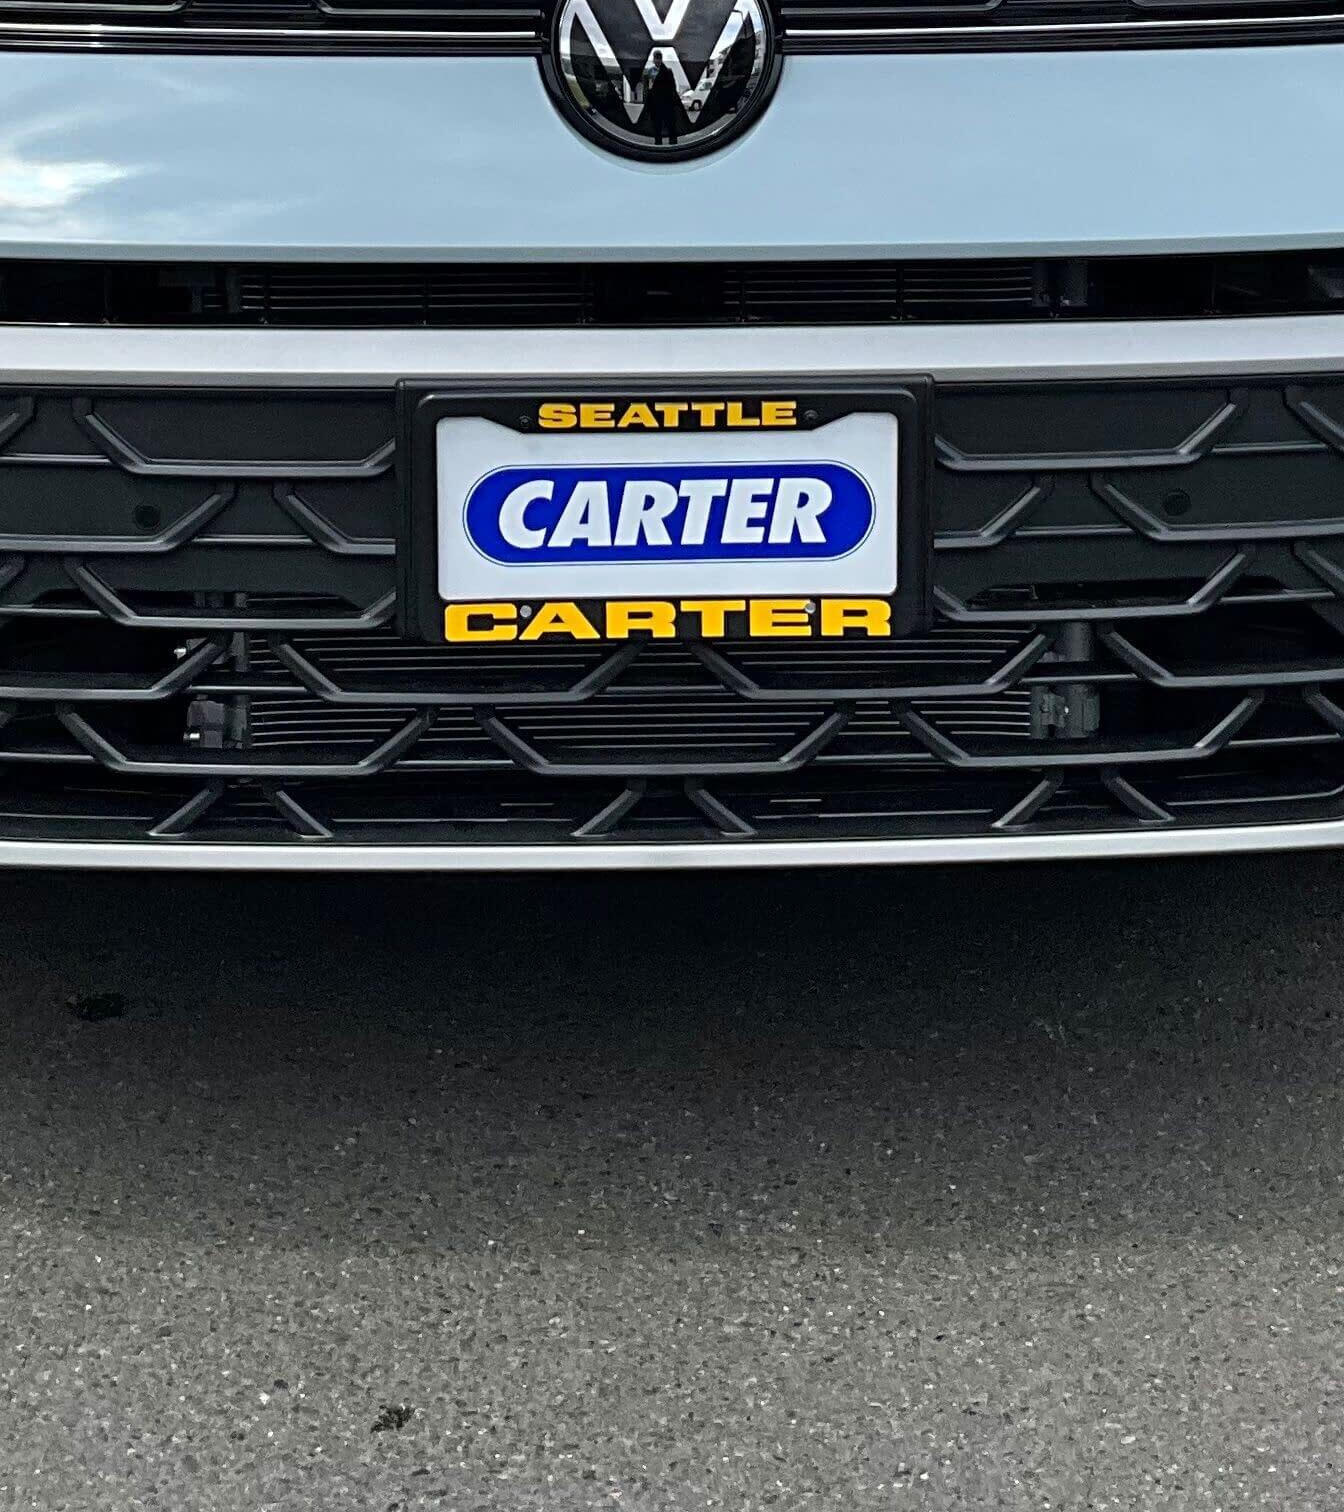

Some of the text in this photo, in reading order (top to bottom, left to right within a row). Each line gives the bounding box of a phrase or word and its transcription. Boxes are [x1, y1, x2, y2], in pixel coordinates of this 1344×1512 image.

[537, 400, 797, 429] SEATTLE
[498, 476, 833, 550] CARTER
[444, 599, 892, 643] CARTER
